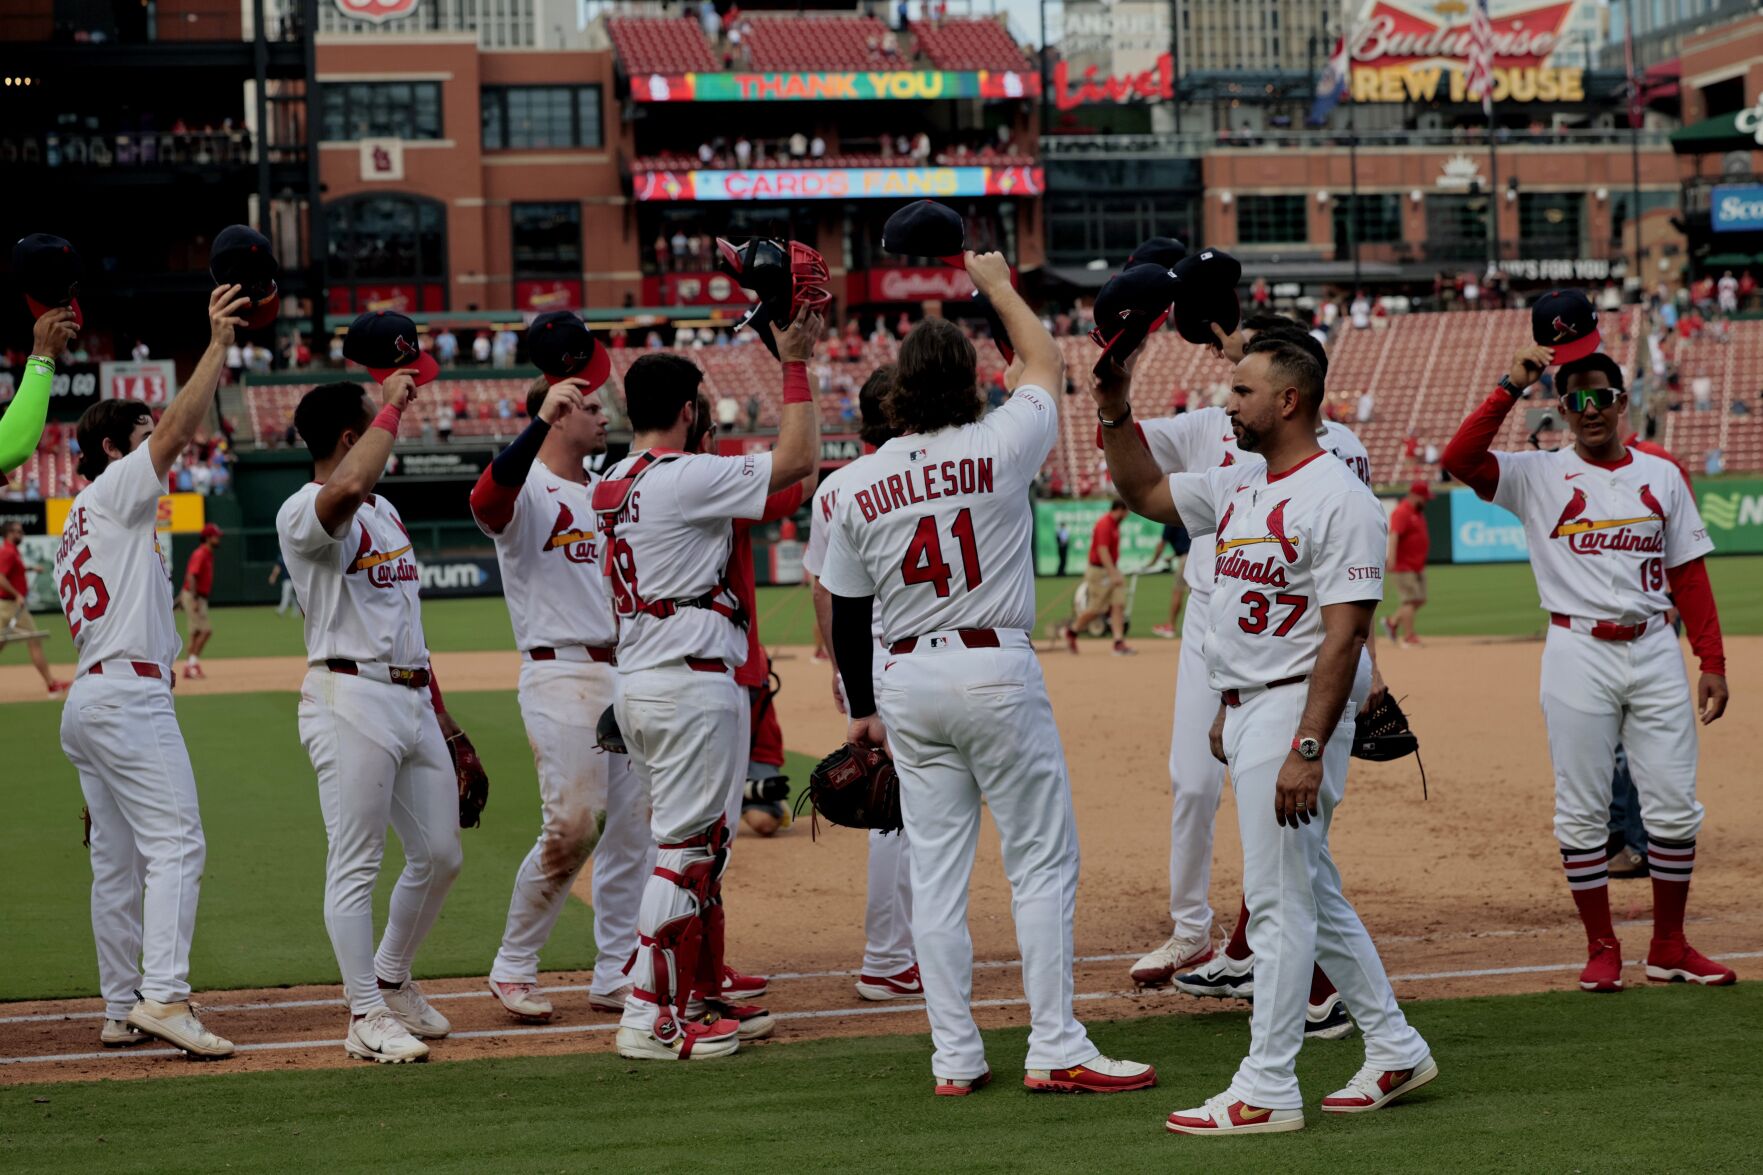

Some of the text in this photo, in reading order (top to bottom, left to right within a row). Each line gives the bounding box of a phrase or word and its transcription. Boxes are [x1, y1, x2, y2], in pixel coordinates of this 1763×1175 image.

[733, 72, 944, 99] THANK YOU
[1352, 67, 1442, 102] REW
[724, 168, 958, 198] CARDS FANS
[855, 457, 993, 524] BURLESON
[901, 507, 983, 598] 41
[1568, 518, 1665, 556] Cardinals
[1348, 567, 1381, 581] STIFEL
[1640, 558, 1664, 592] 19
[59, 545, 110, 641] 25
[1238, 590, 1309, 637] 37
